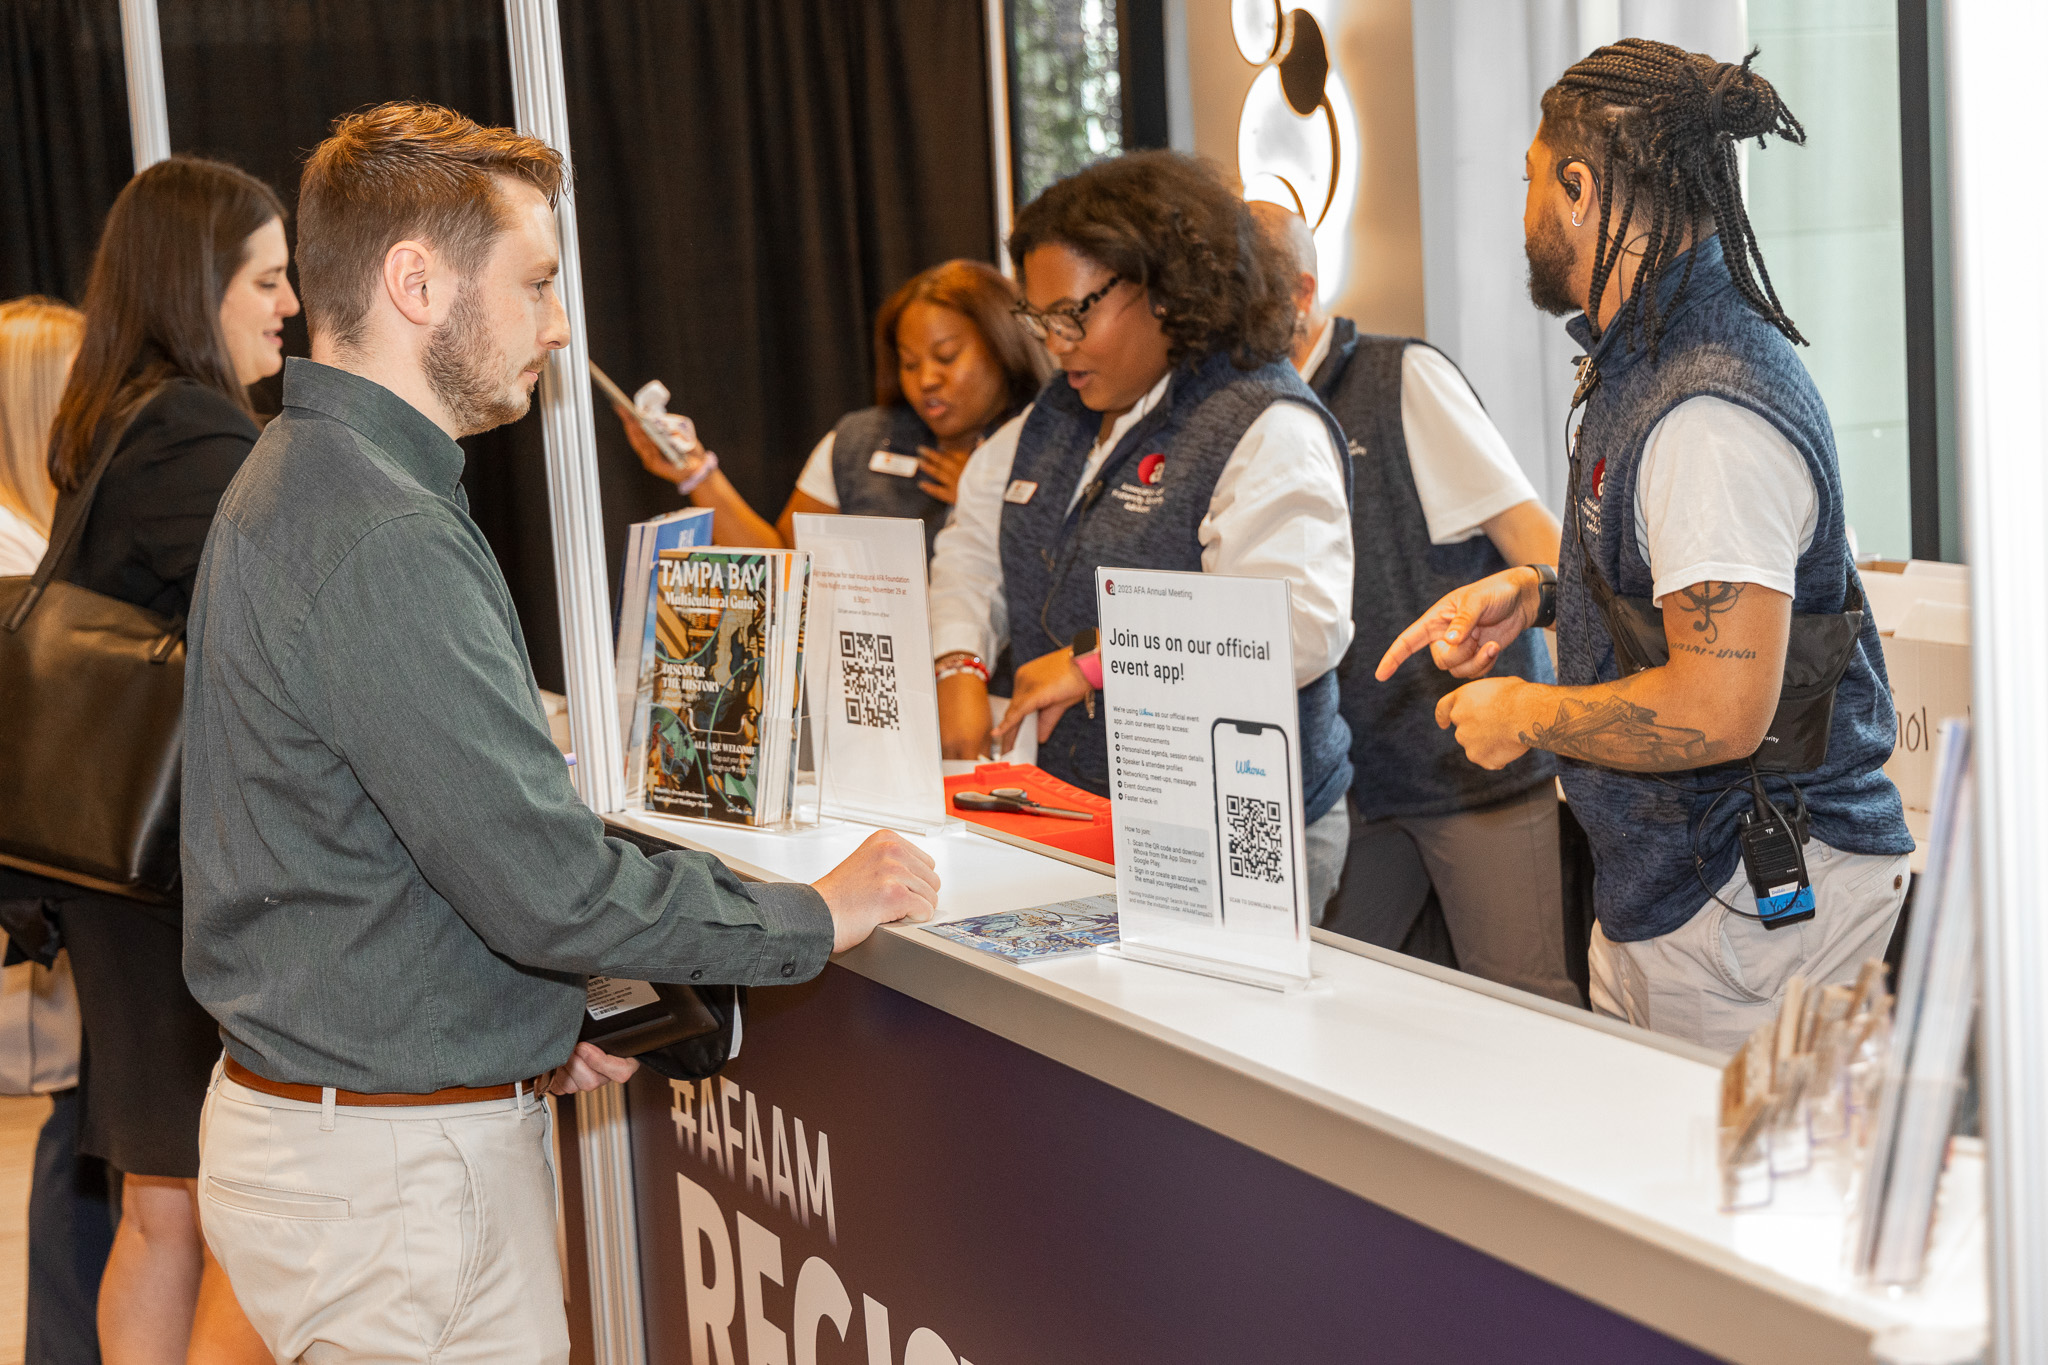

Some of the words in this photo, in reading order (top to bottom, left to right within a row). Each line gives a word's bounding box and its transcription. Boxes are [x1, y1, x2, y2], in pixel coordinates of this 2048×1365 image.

[659, 559, 725, 589] TAMPA
[727, 563, 765, 592] BAY
[1118, 584, 1133, 594] 2023
[1134, 586, 1146, 594] AFA
[1146, 587, 1167, 596] Annual
[1168, 588, 1193, 600] Meeting
[664, 591, 729, 609] Multicultural
[729, 595, 758, 611] Guide
[1109, 628, 1139, 648] Join
[1144, 634, 1160, 650] us
[1165, 637, 1182, 652] on
[1187, 640, 1212, 656] our
[1216, 638, 1270, 661] official
[662, 663, 706, 678] DISCOVER
[1110, 660, 1150, 678] event
[1154, 662, 1185, 685] app!
[662, 677, 681, 689] THE
[682, 678, 721, 693] HISTORY
[1113, 706, 1126, 714] We're
[1126, 708, 1138, 716] using
[1170, 712, 1186, 720] official
[694, 740, 707, 750] ALL
[708, 742, 722, 752] ARE
[722, 743, 756, 755] WELCOME
[1134, 735, 1170, 746] announcements
[1122, 745, 1150, 756] Personalized
[1151, 750, 1169, 758] agenda,
[1169, 752, 1188, 760] session
[1188, 754, 1205, 762] details
[1122, 758, 1140, 766] Speaker
[1146, 761, 1165, 770] attendee
[1166, 764, 1184, 772] profiles
[1235, 760, 1266, 777] Whova
[1123, 770, 1149, 780] Networking,
[1173, 777, 1197, 787] messages
[1137, 784, 1162, 794] documents
[1139, 796, 1158, 805] check-in
[1133, 848, 1148, 856] Whova
[1149, 850, 1160, 858] from
[1169, 854, 1178, 863] App
[1179, 856, 1191, 864] Store
[1160, 844, 1172, 852] code
[1182, 848, 1204, 858] download
[1133, 856, 1149, 866] Google
[1134, 867, 1144, 875] Sign
[1177, 875, 1196, 884] account
[1143, 877, 1155, 885] email
[1165, 881, 1188, 891] registered
[669, 1075, 837, 1248] #AFAAM
